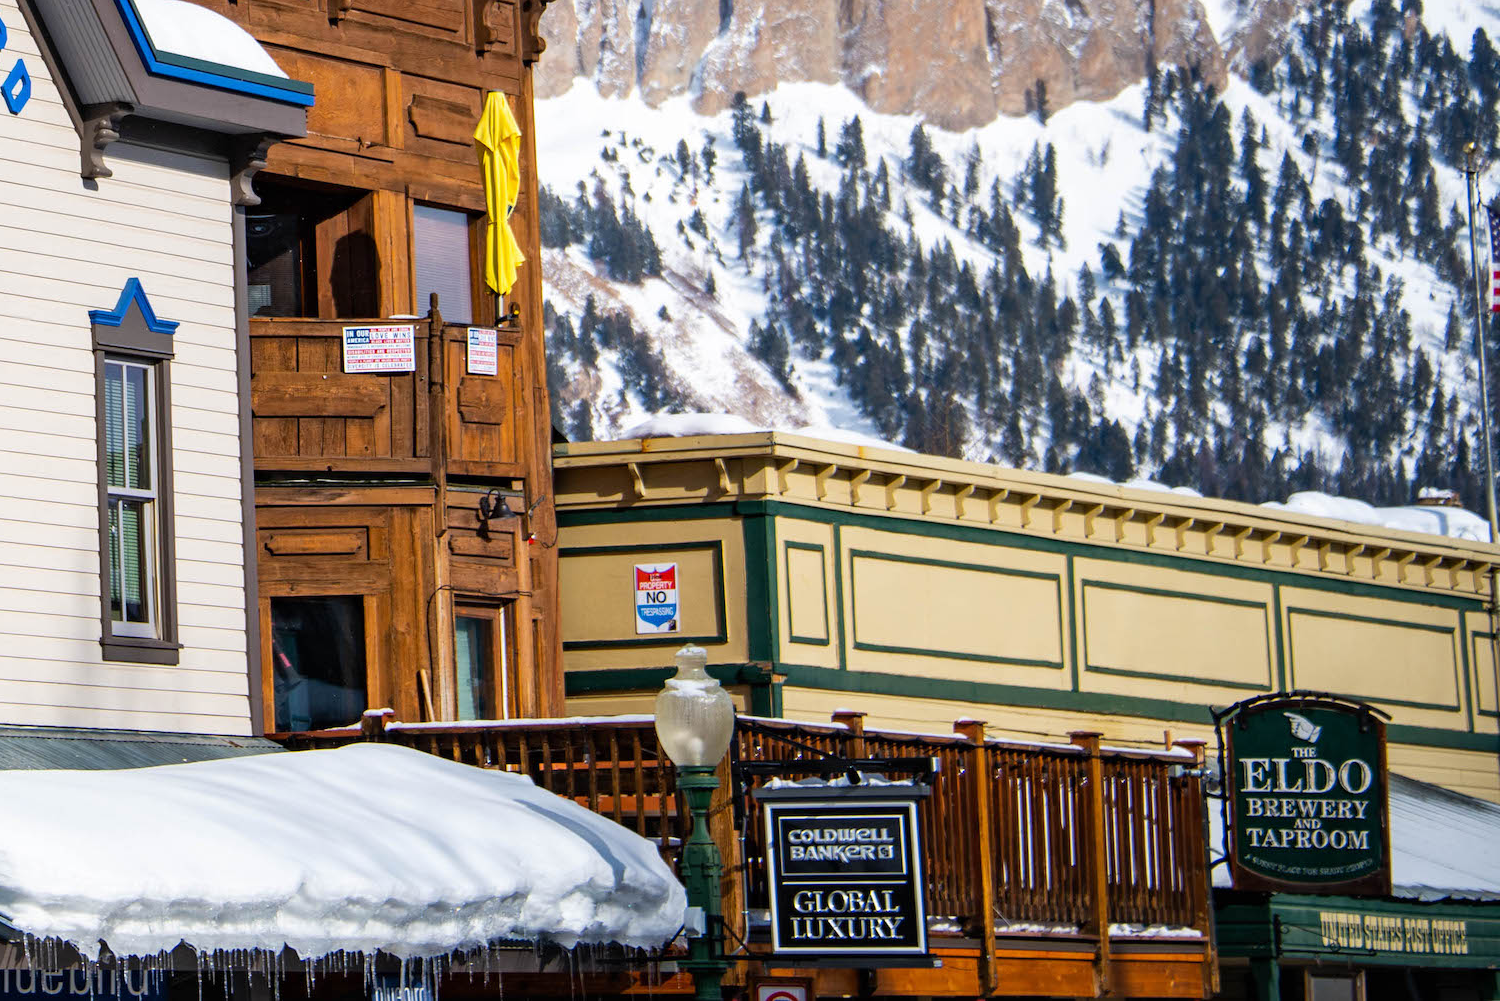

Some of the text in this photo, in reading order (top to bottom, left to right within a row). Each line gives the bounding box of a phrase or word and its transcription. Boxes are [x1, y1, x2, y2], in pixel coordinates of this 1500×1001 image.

[346, 330, 370, 338] IN OUR
[393, 331, 411, 339] WINS
[639, 581, 673, 590] PROPERTY
[646, 591, 667, 603] NO
[640, 607, 674, 616] TRESPASSING
[1291, 747, 1317, 758] THE
[1239, 758, 1372, 794] ELDO
[1246, 798, 1368, 819] BREWERY
[1293, 819, 1322, 830] AND
[1246, 828, 1370, 850] TAPROOM
[790, 845, 877, 864] BANKER
[794, 890, 900, 913] GLOBAL
[790, 917, 905, 939] LUXURY
[1320, 912, 1468, 954] UNITED STATES POST OFFICE
